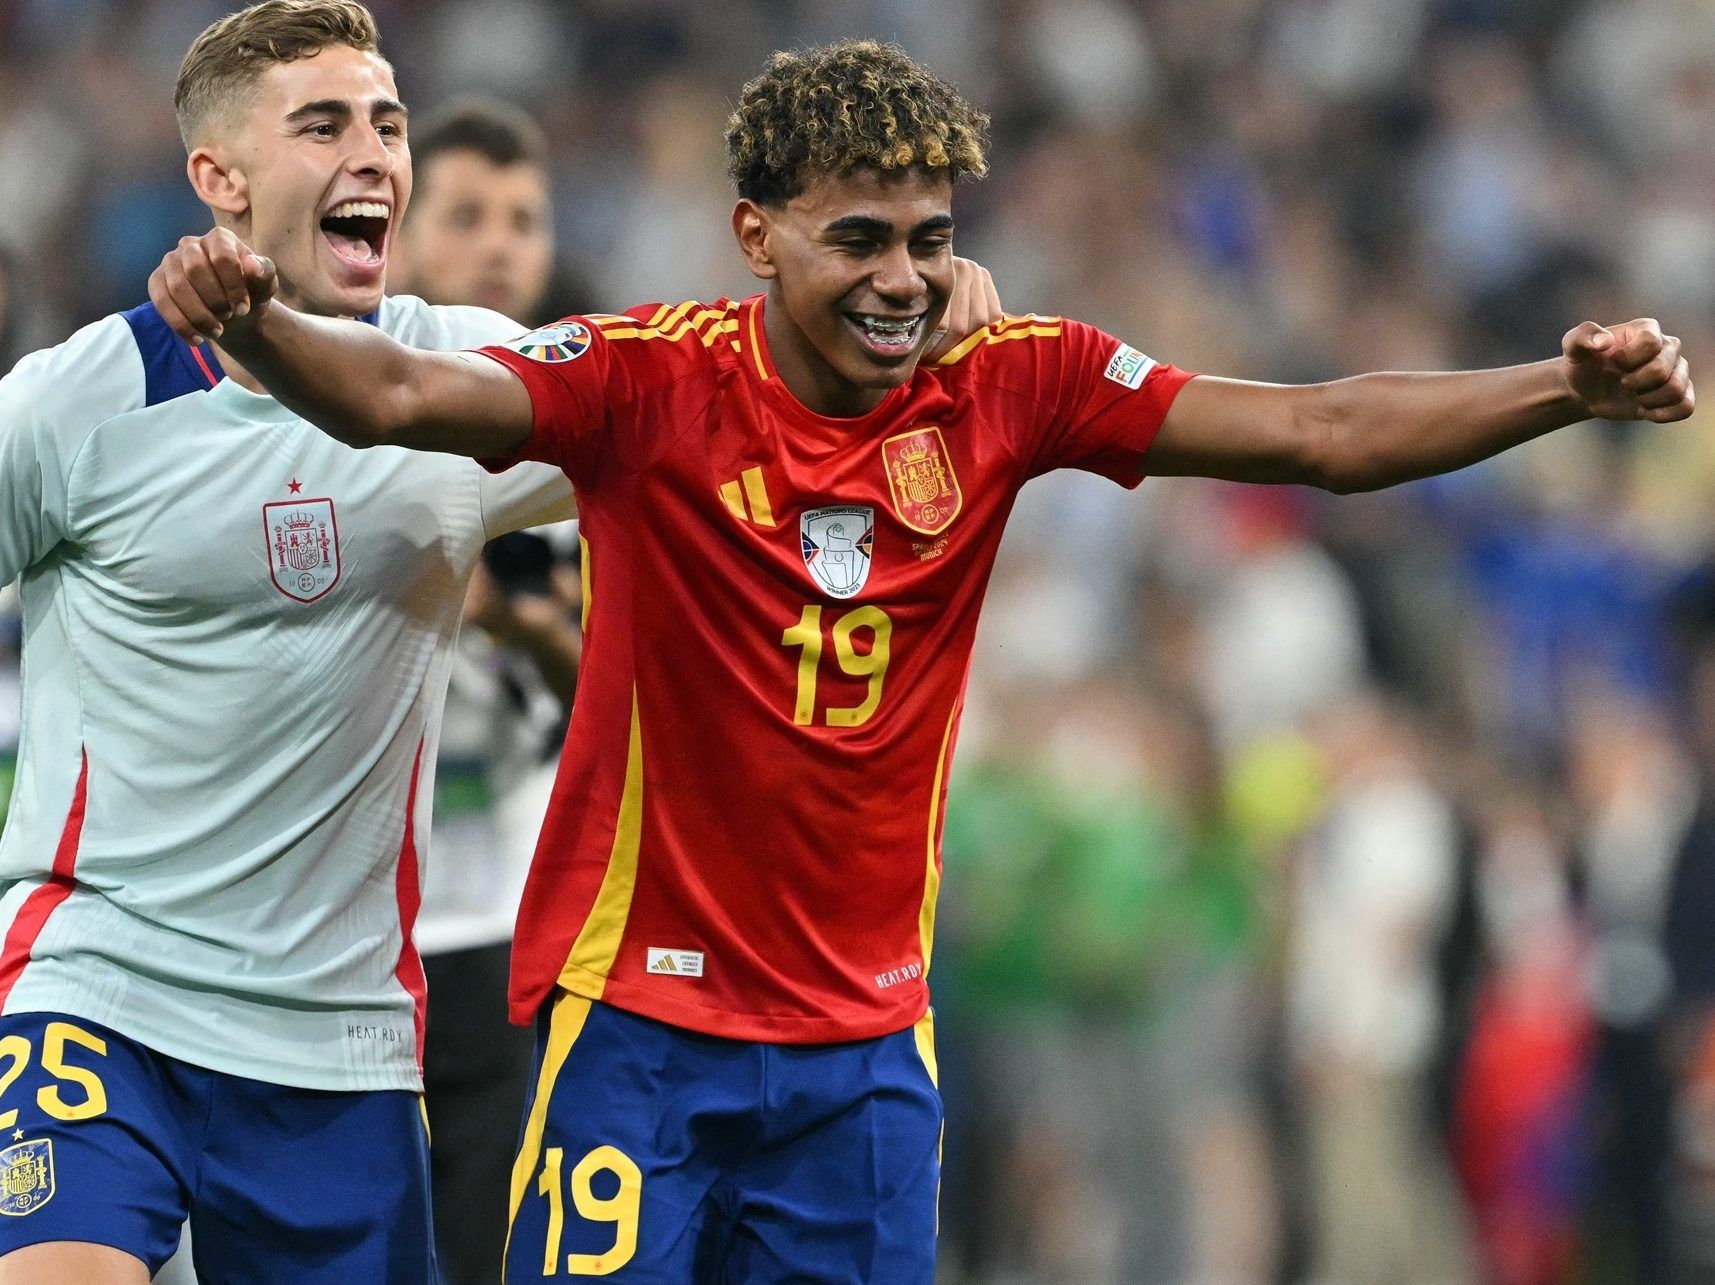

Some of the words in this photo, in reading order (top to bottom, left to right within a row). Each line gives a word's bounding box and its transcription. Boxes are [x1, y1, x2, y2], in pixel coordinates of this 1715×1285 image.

[1107, 355, 1124, 378] UEFA
[826, 585, 849, 596] WINNER
[781, 605, 892, 727] 19
[875, 962, 922, 989] HEAT.RDY
[347, 1025, 402, 1042] HEAT.RDY
[0, 1022, 107, 1131] 25
[538, 1145, 642, 1276] 19
